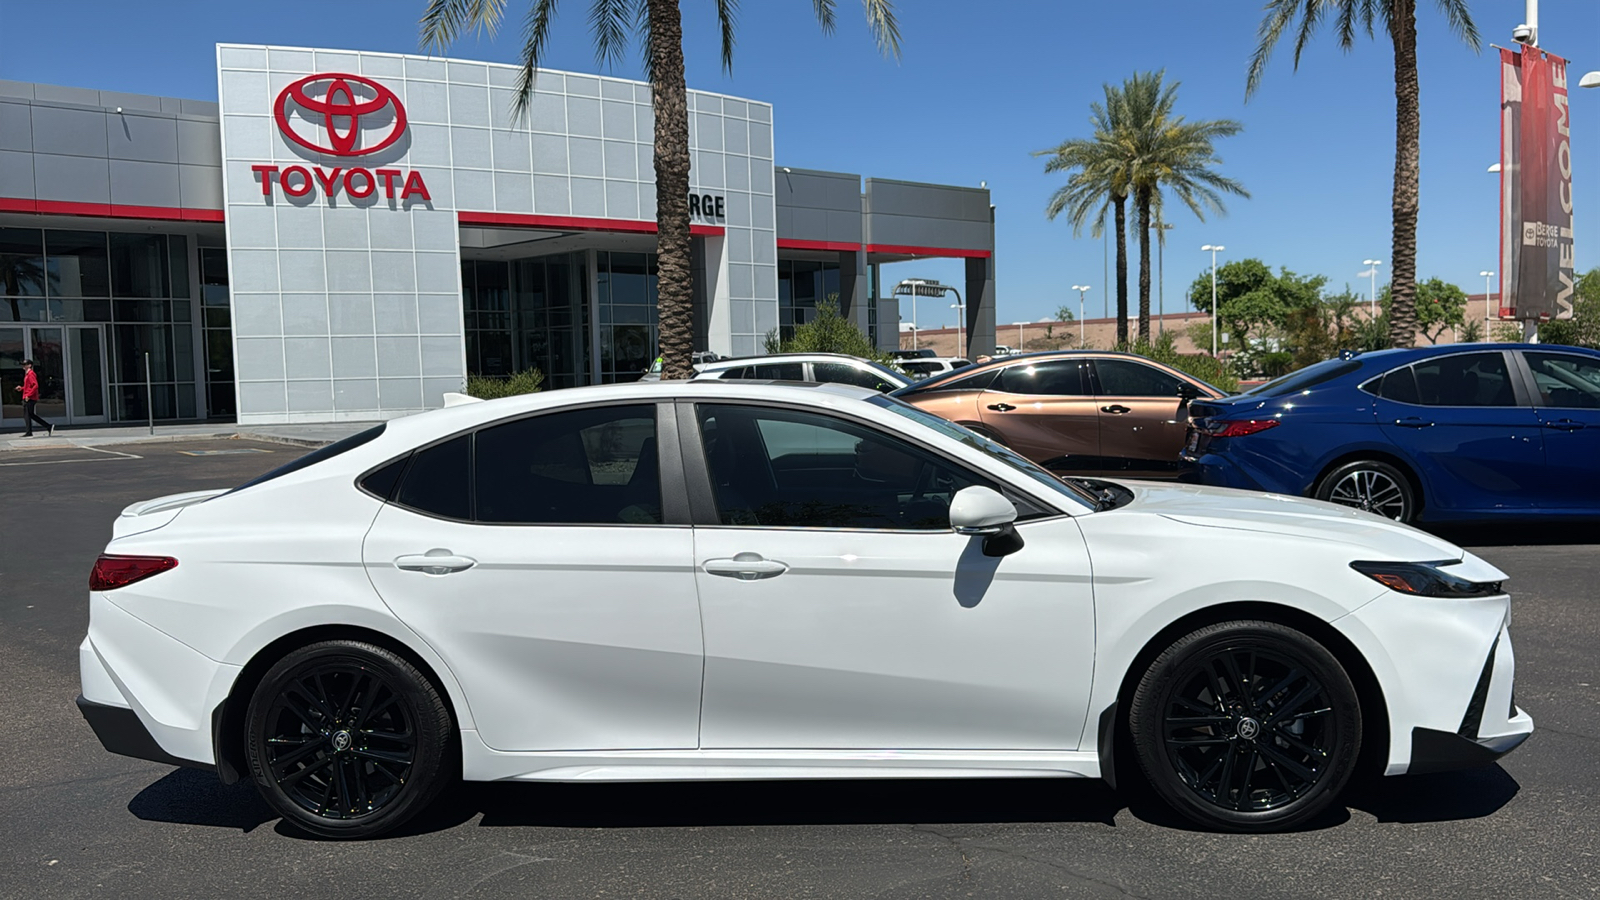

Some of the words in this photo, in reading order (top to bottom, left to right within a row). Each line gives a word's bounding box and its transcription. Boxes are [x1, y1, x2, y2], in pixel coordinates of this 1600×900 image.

[251, 165, 432, 201] TOYOTA
[1552, 62, 1574, 320] WELCOME
[688, 193, 725, 218] RGE
[1536, 221, 1559, 237] BERGE
[1536, 237, 1559, 249] TOYOTA
